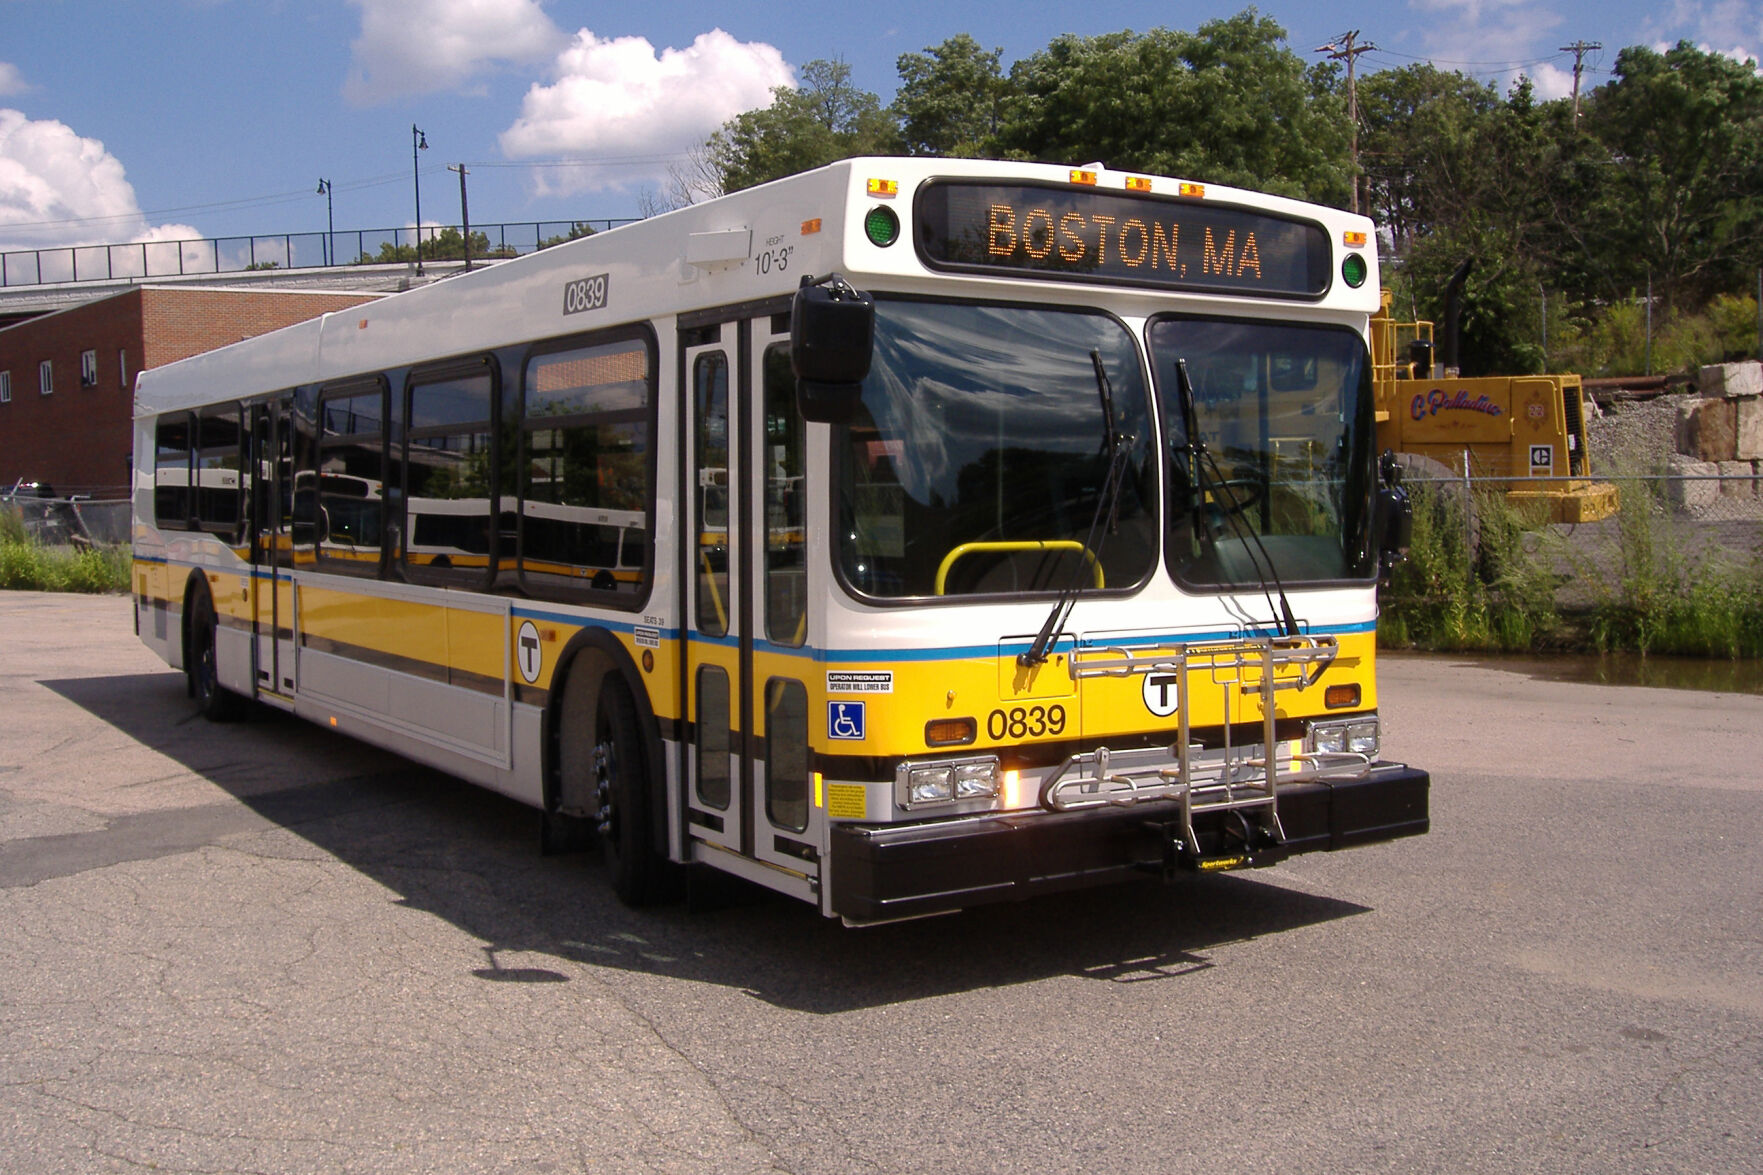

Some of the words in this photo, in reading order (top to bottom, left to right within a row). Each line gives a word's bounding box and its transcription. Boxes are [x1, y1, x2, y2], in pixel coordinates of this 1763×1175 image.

[988, 203, 1187, 278] BOSTON,
[1203, 225, 1262, 279] MA
[567, 276, 605, 313] 0839
[643, 616, 657, 625] SEATS
[521, 636, 538, 673] T
[830, 683, 852, 691] OPERATOR
[853, 683, 863, 691] WILL
[864, 683, 880, 691] LOWER
[880, 683, 890, 691] BUS
[1150, 675, 1177, 707] T
[987, 704, 1066, 741] 0839
